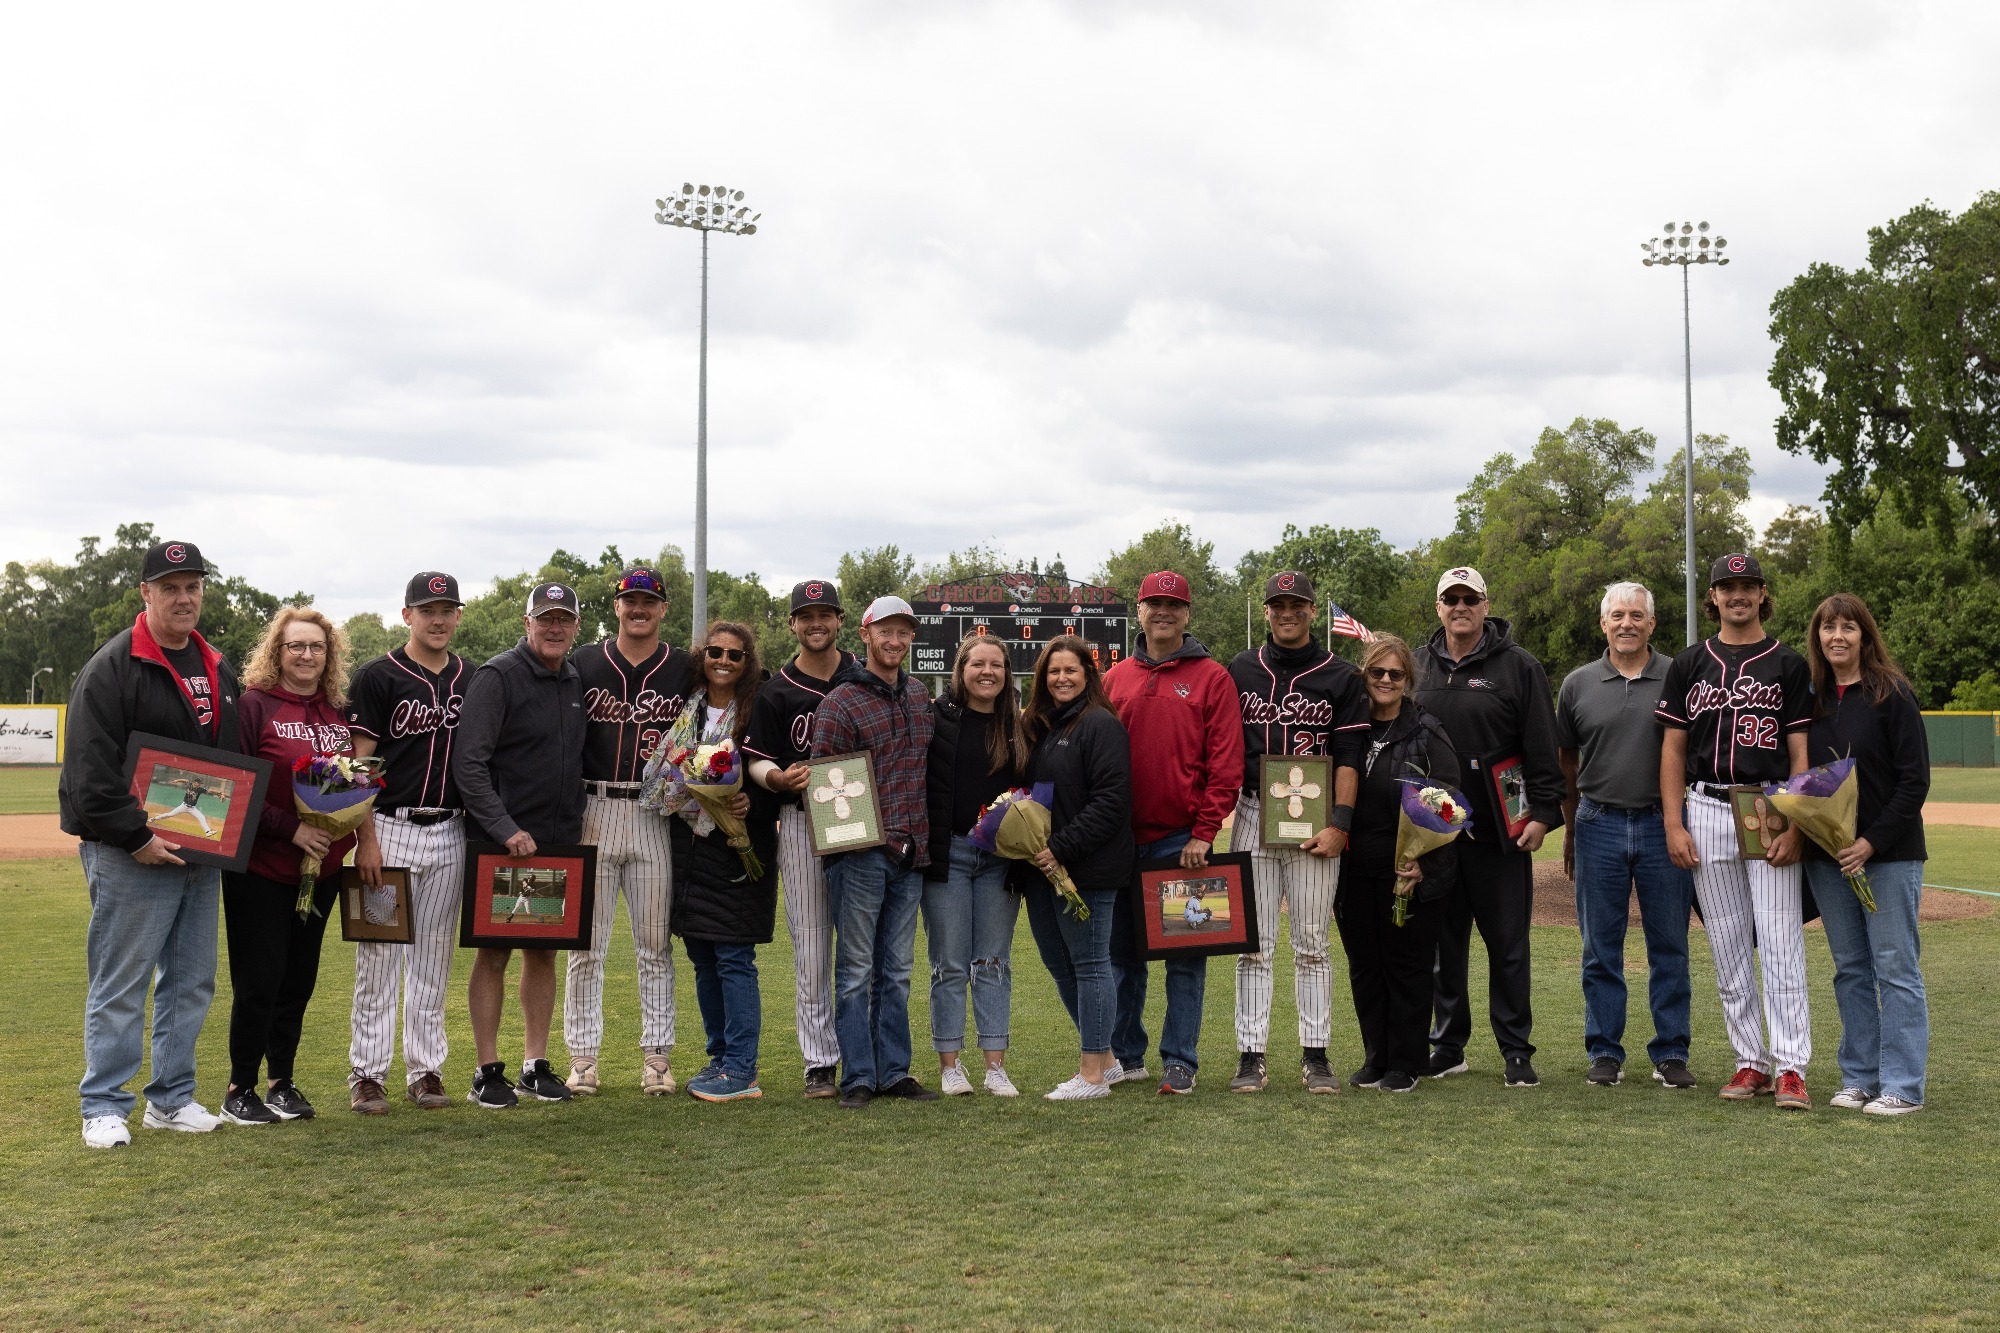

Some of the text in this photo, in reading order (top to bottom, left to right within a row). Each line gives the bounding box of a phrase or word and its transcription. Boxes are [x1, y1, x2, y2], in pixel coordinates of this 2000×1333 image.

[166, 544, 187, 563] C
[1728, 556, 1747, 573] C
[428, 576, 447, 595] C
[1158, 575, 1176, 592] C
[1278, 574, 1295, 591] C
[805, 583, 824, 600] C
[927, 585, 1118, 604] CHICO STATE
[952, 605, 974, 614] pepsi
[1020, 606, 1042, 614] pepsi
[920, 617, 944, 625] AT BAT
[973, 617, 991, 625] BALL
[1015, 618, 1040, 626] STRIKE
[1062, 618, 1077, 626] OUT
[1105, 619, 1117, 627] H/E
[1023, 625, 1031, 639] 0
[1013, 642, 1018, 650] 7
[1022, 642, 1027, 650] 8
[1031, 642, 1036, 650] 9
[916, 649, 946, 659] GUEST
[1111, 649, 1118, 660] 0
[917, 661, 945, 671] CHICO
[1278, 692, 1333, 726] State
[389, 699, 447, 739] Chico
[1737, 714, 1779, 750] 32
[640, 729, 670, 761] 3
[1293, 730, 1330, 757] 27
